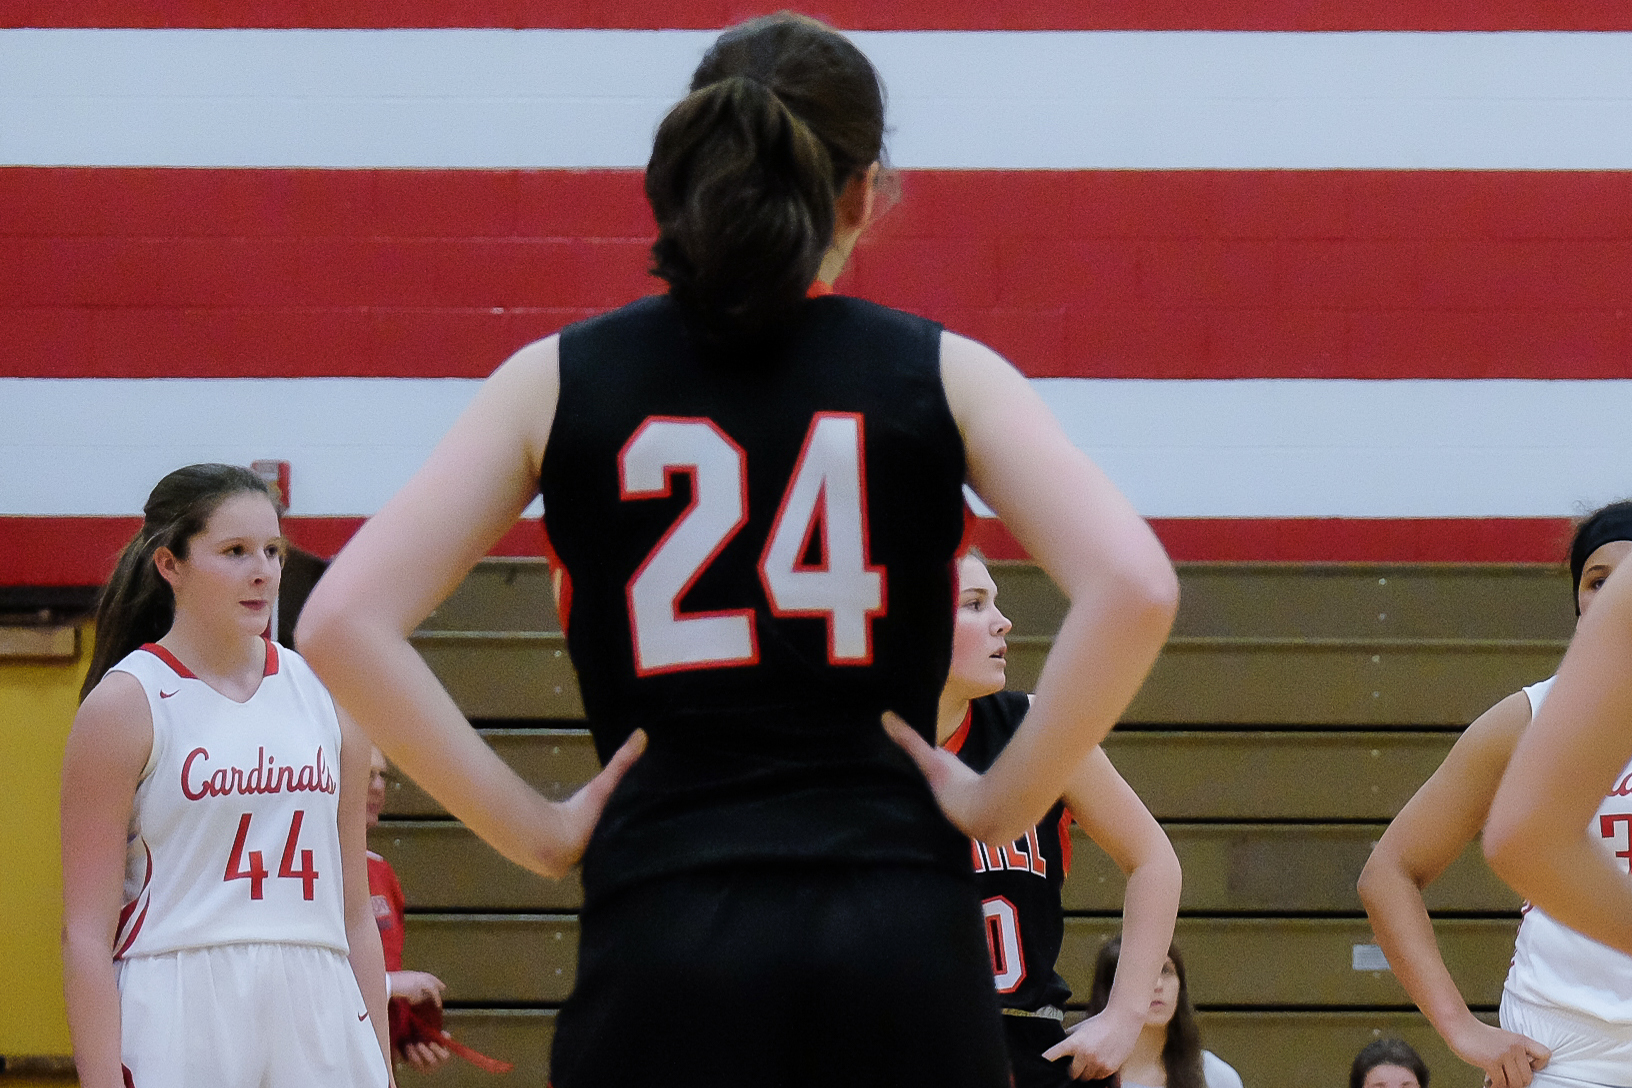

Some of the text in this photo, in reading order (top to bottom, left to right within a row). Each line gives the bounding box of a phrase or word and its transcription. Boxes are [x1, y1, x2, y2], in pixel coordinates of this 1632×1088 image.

[616, 410, 888, 678] 24
[181, 745, 337, 801] Cardinals
[223, 810, 319, 901] 44
